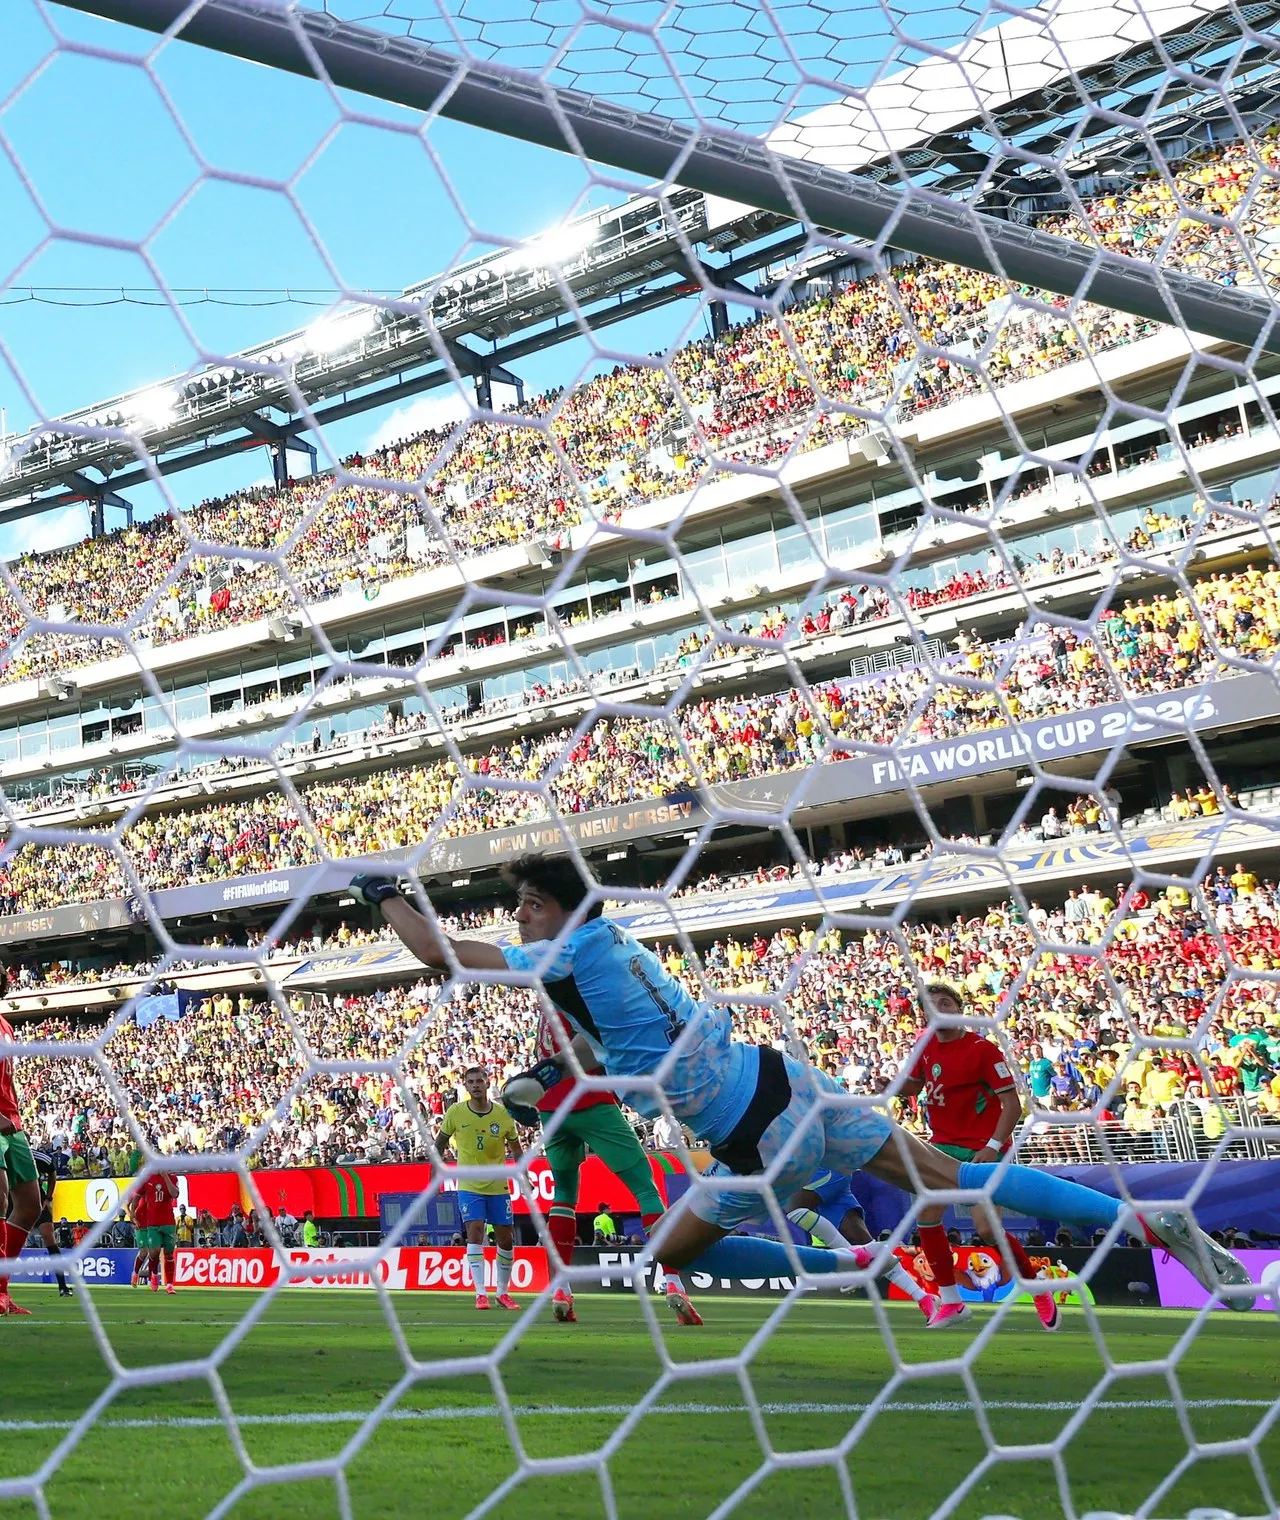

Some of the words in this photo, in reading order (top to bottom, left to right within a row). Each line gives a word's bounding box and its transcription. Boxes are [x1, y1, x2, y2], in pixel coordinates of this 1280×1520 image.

[872, 754, 931, 784] FIFA
[931, 732, 1029, 771] WORLD
[1037, 719, 1096, 754] CUP
[1100, 694, 1215, 739] 2026
[489, 834, 527, 855] NEW
[530, 823, 578, 847] YORK
[579, 816, 619, 839] NEW
[622, 801, 693, 831] JERSEY
[222, 879, 290, 901] #FIFAWorldCup
[9, 916, 55, 936] JERSEY
[926, 1081, 946, 1107] 24
[477, 1136, 484, 1151] 8
[85, 1178, 119, 1222] 0
[154, 1190, 164, 1203] 10
[63, 1257, 111, 1277] 026
[175, 1250, 264, 1283] Betano
[418, 1250, 533, 1289] Beto
